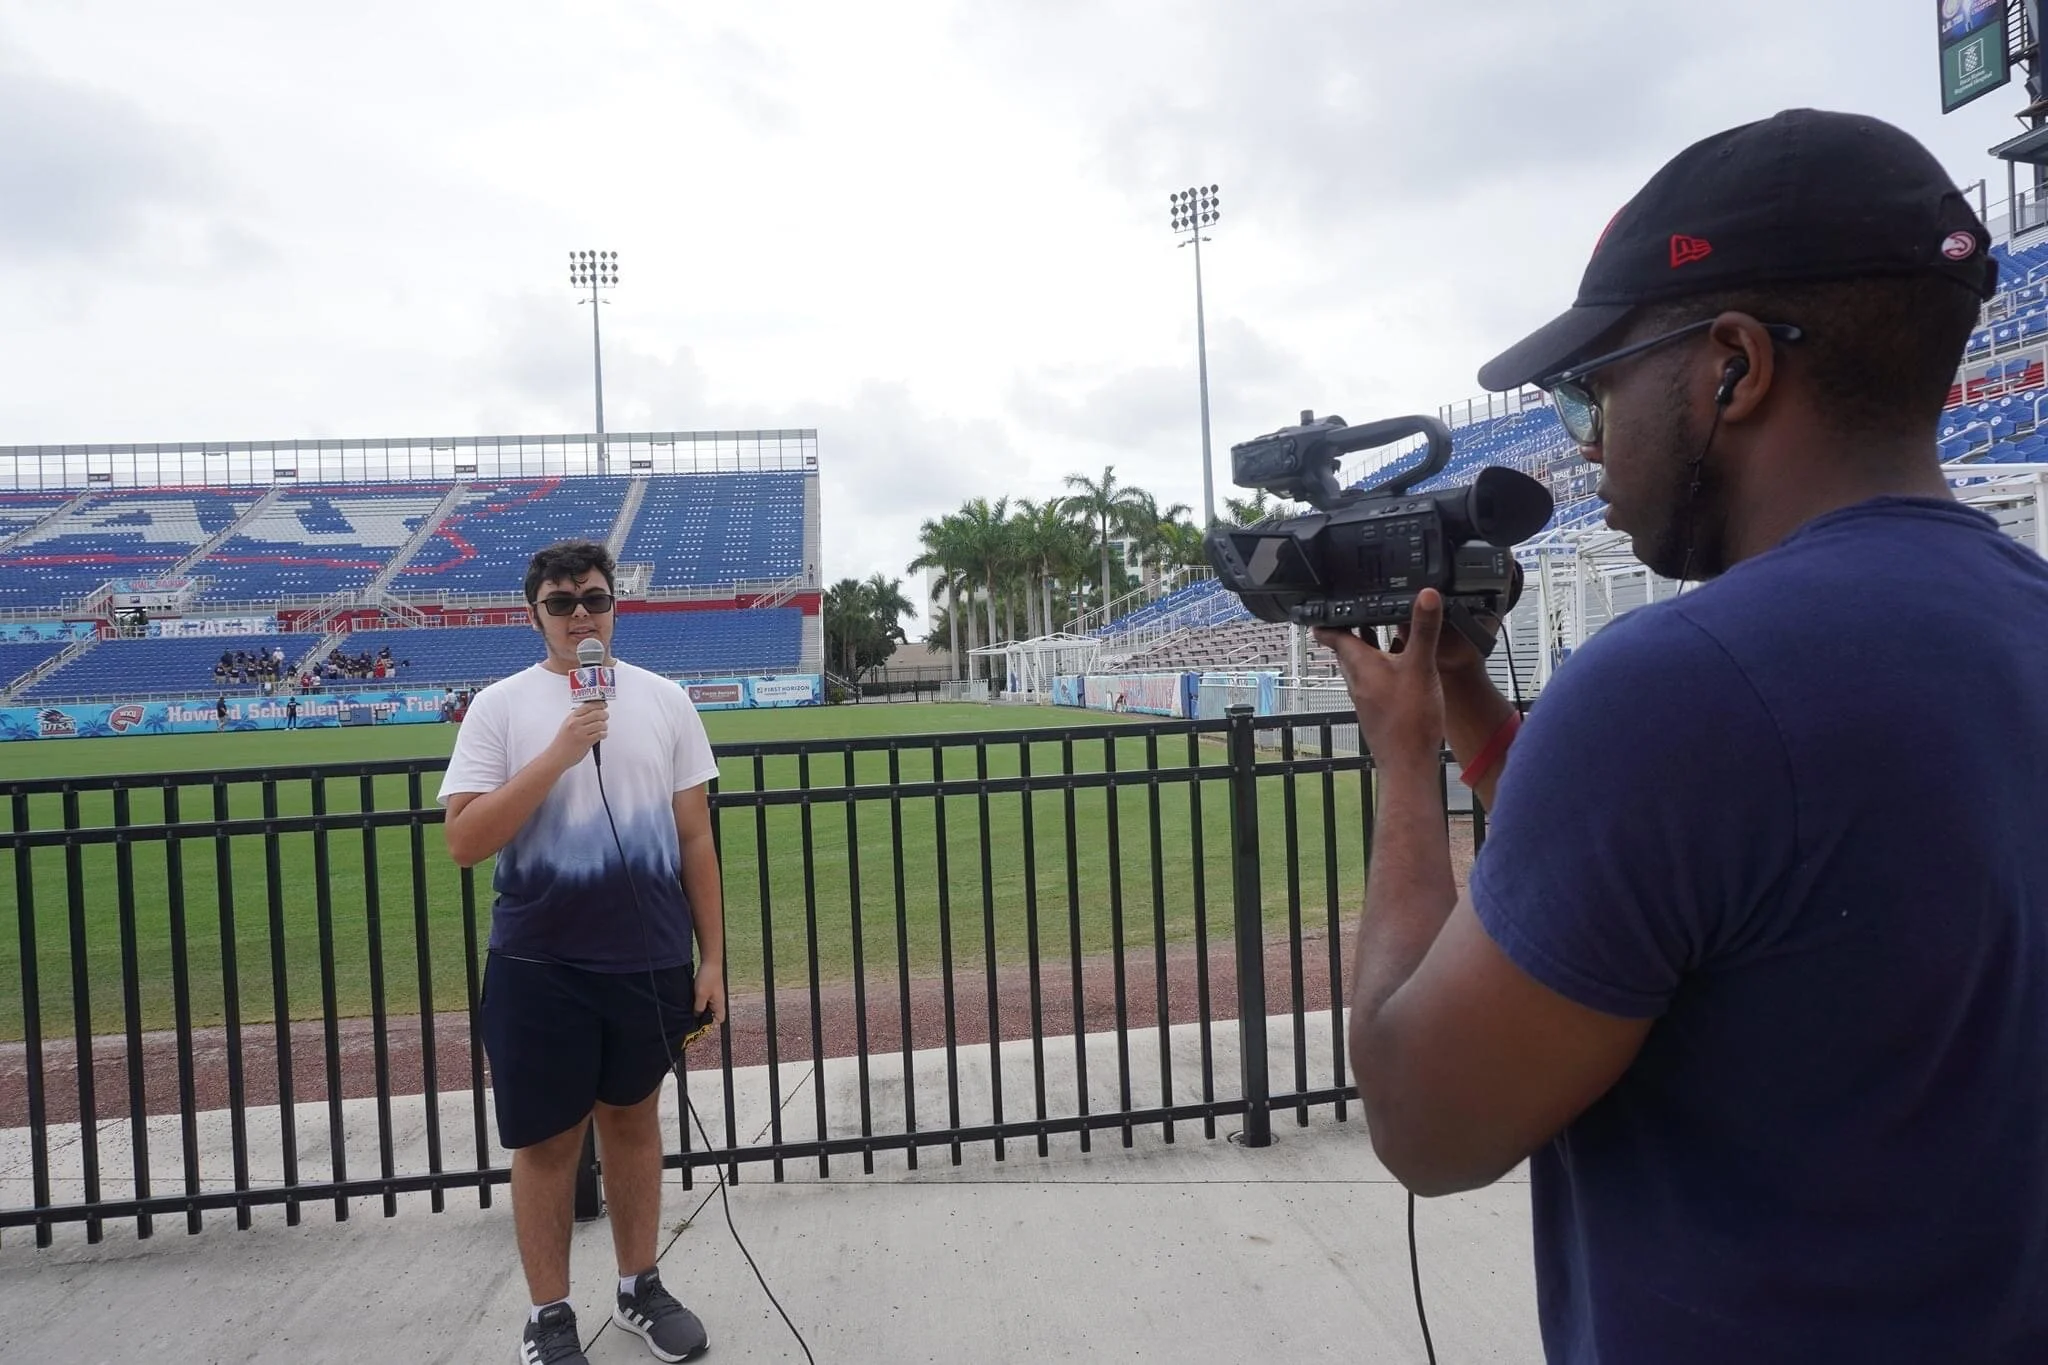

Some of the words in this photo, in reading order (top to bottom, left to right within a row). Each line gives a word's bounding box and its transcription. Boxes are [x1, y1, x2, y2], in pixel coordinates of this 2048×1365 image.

[782, 684, 810, 692] HORIZON
[407, 695, 443, 712] Fiel
[42, 720, 75, 731] UTSA
